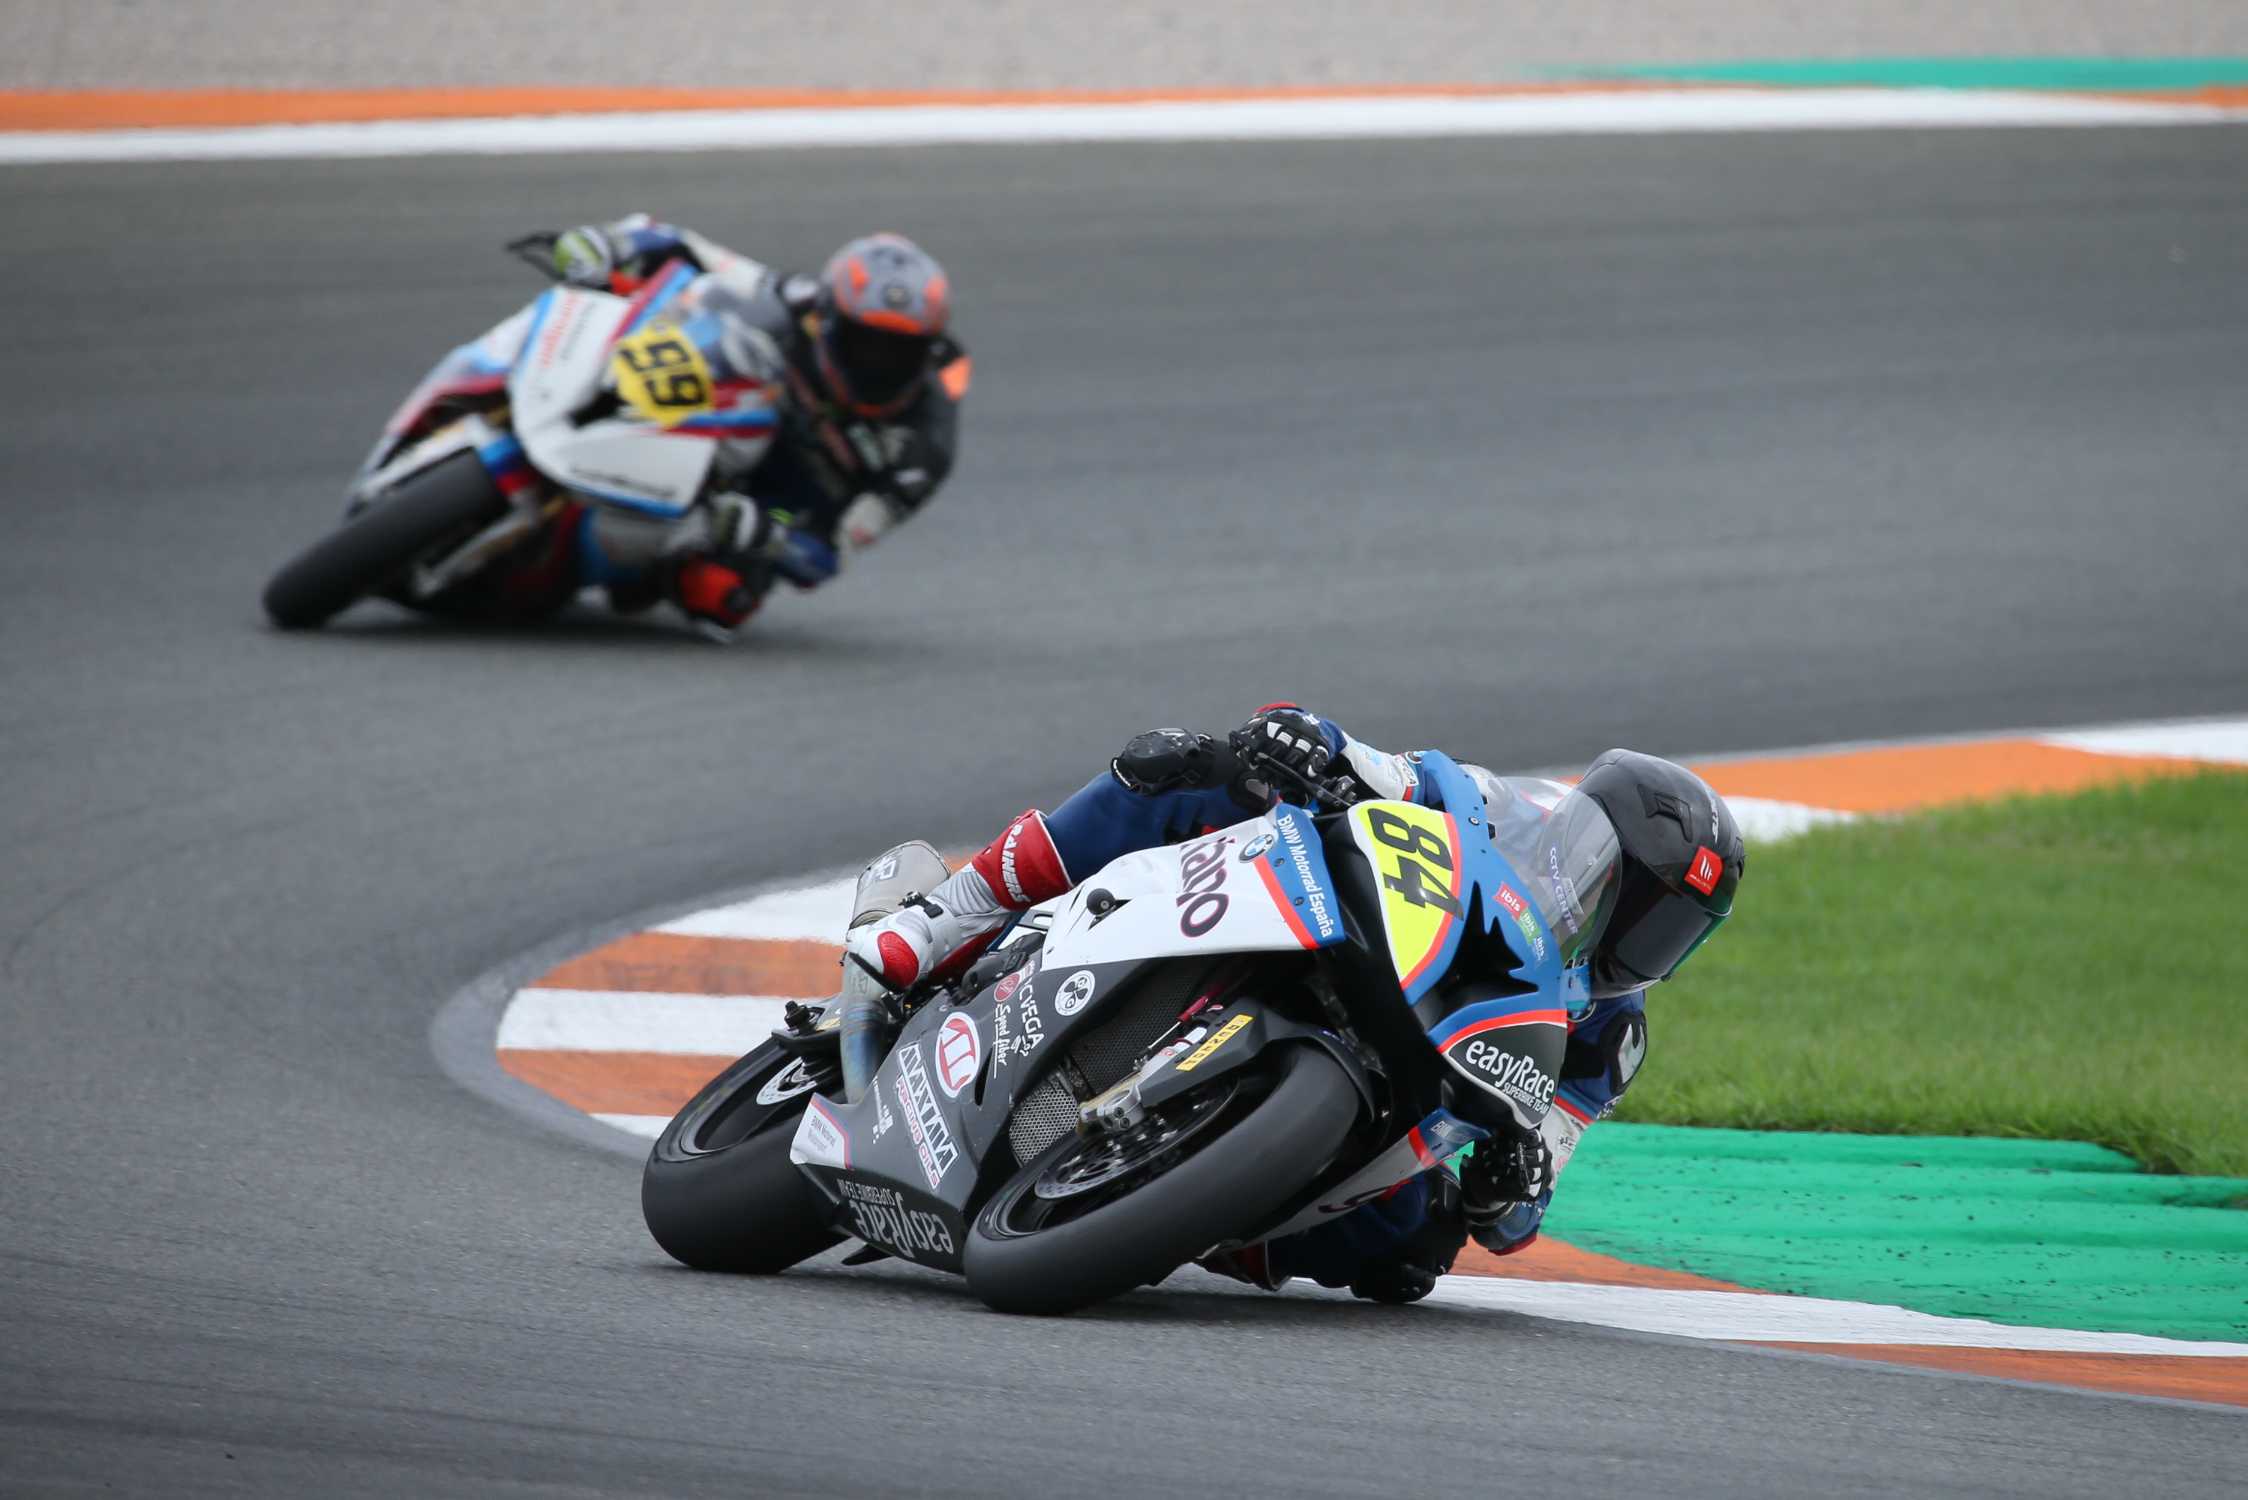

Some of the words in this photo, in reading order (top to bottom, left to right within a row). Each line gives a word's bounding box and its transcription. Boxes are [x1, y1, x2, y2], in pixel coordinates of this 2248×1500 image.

[619, 339, 707, 406] 99
[1277, 814, 1297, 844] BMW
[1290, 846, 1324, 897] Motorrad
[1309, 893, 1333, 938] España
[1367, 808, 1464, 921] 84
[1549, 847, 1560, 880] CCTV
[1555, 886, 1578, 934] CENTER
[1501, 889, 1521, 912] ibis
[1465, 1040, 1555, 1102] easyRace
[1503, 1082, 1535, 1108] SUPERBIKE
[1532, 1098, 1550, 1116] TEAM
[898, 1043, 958, 1178] MAXIMA
[918, 1142, 941, 1190] OILS
[848, 1191, 954, 1258] easyRace
